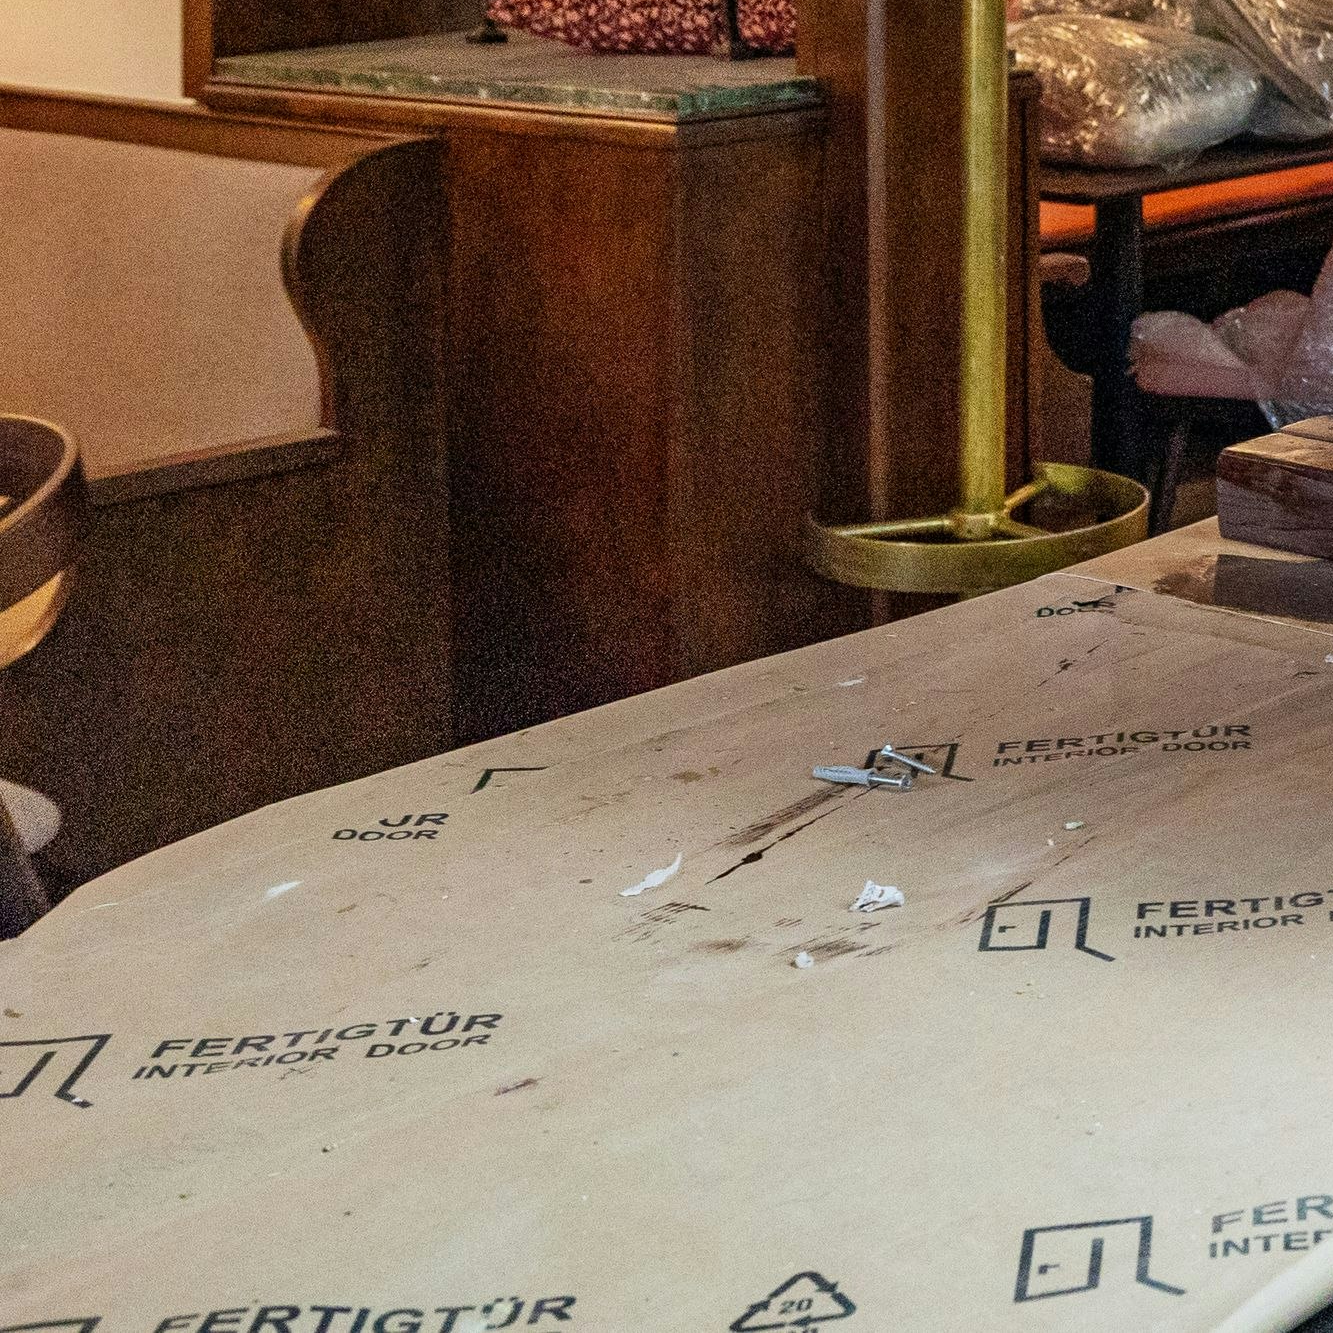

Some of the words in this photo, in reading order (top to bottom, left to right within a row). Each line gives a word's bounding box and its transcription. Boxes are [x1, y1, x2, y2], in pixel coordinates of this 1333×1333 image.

[1162, 740, 1251, 753] DOOR
[331, 828, 439, 842] DOOR
[1133, 914, 1305, 939] INTERIOR
[150, 1010, 504, 1059] FERTIGTÜR
[131, 1044, 341, 1080] INTERIOR
[364, 1033, 493, 1059] DOOR
